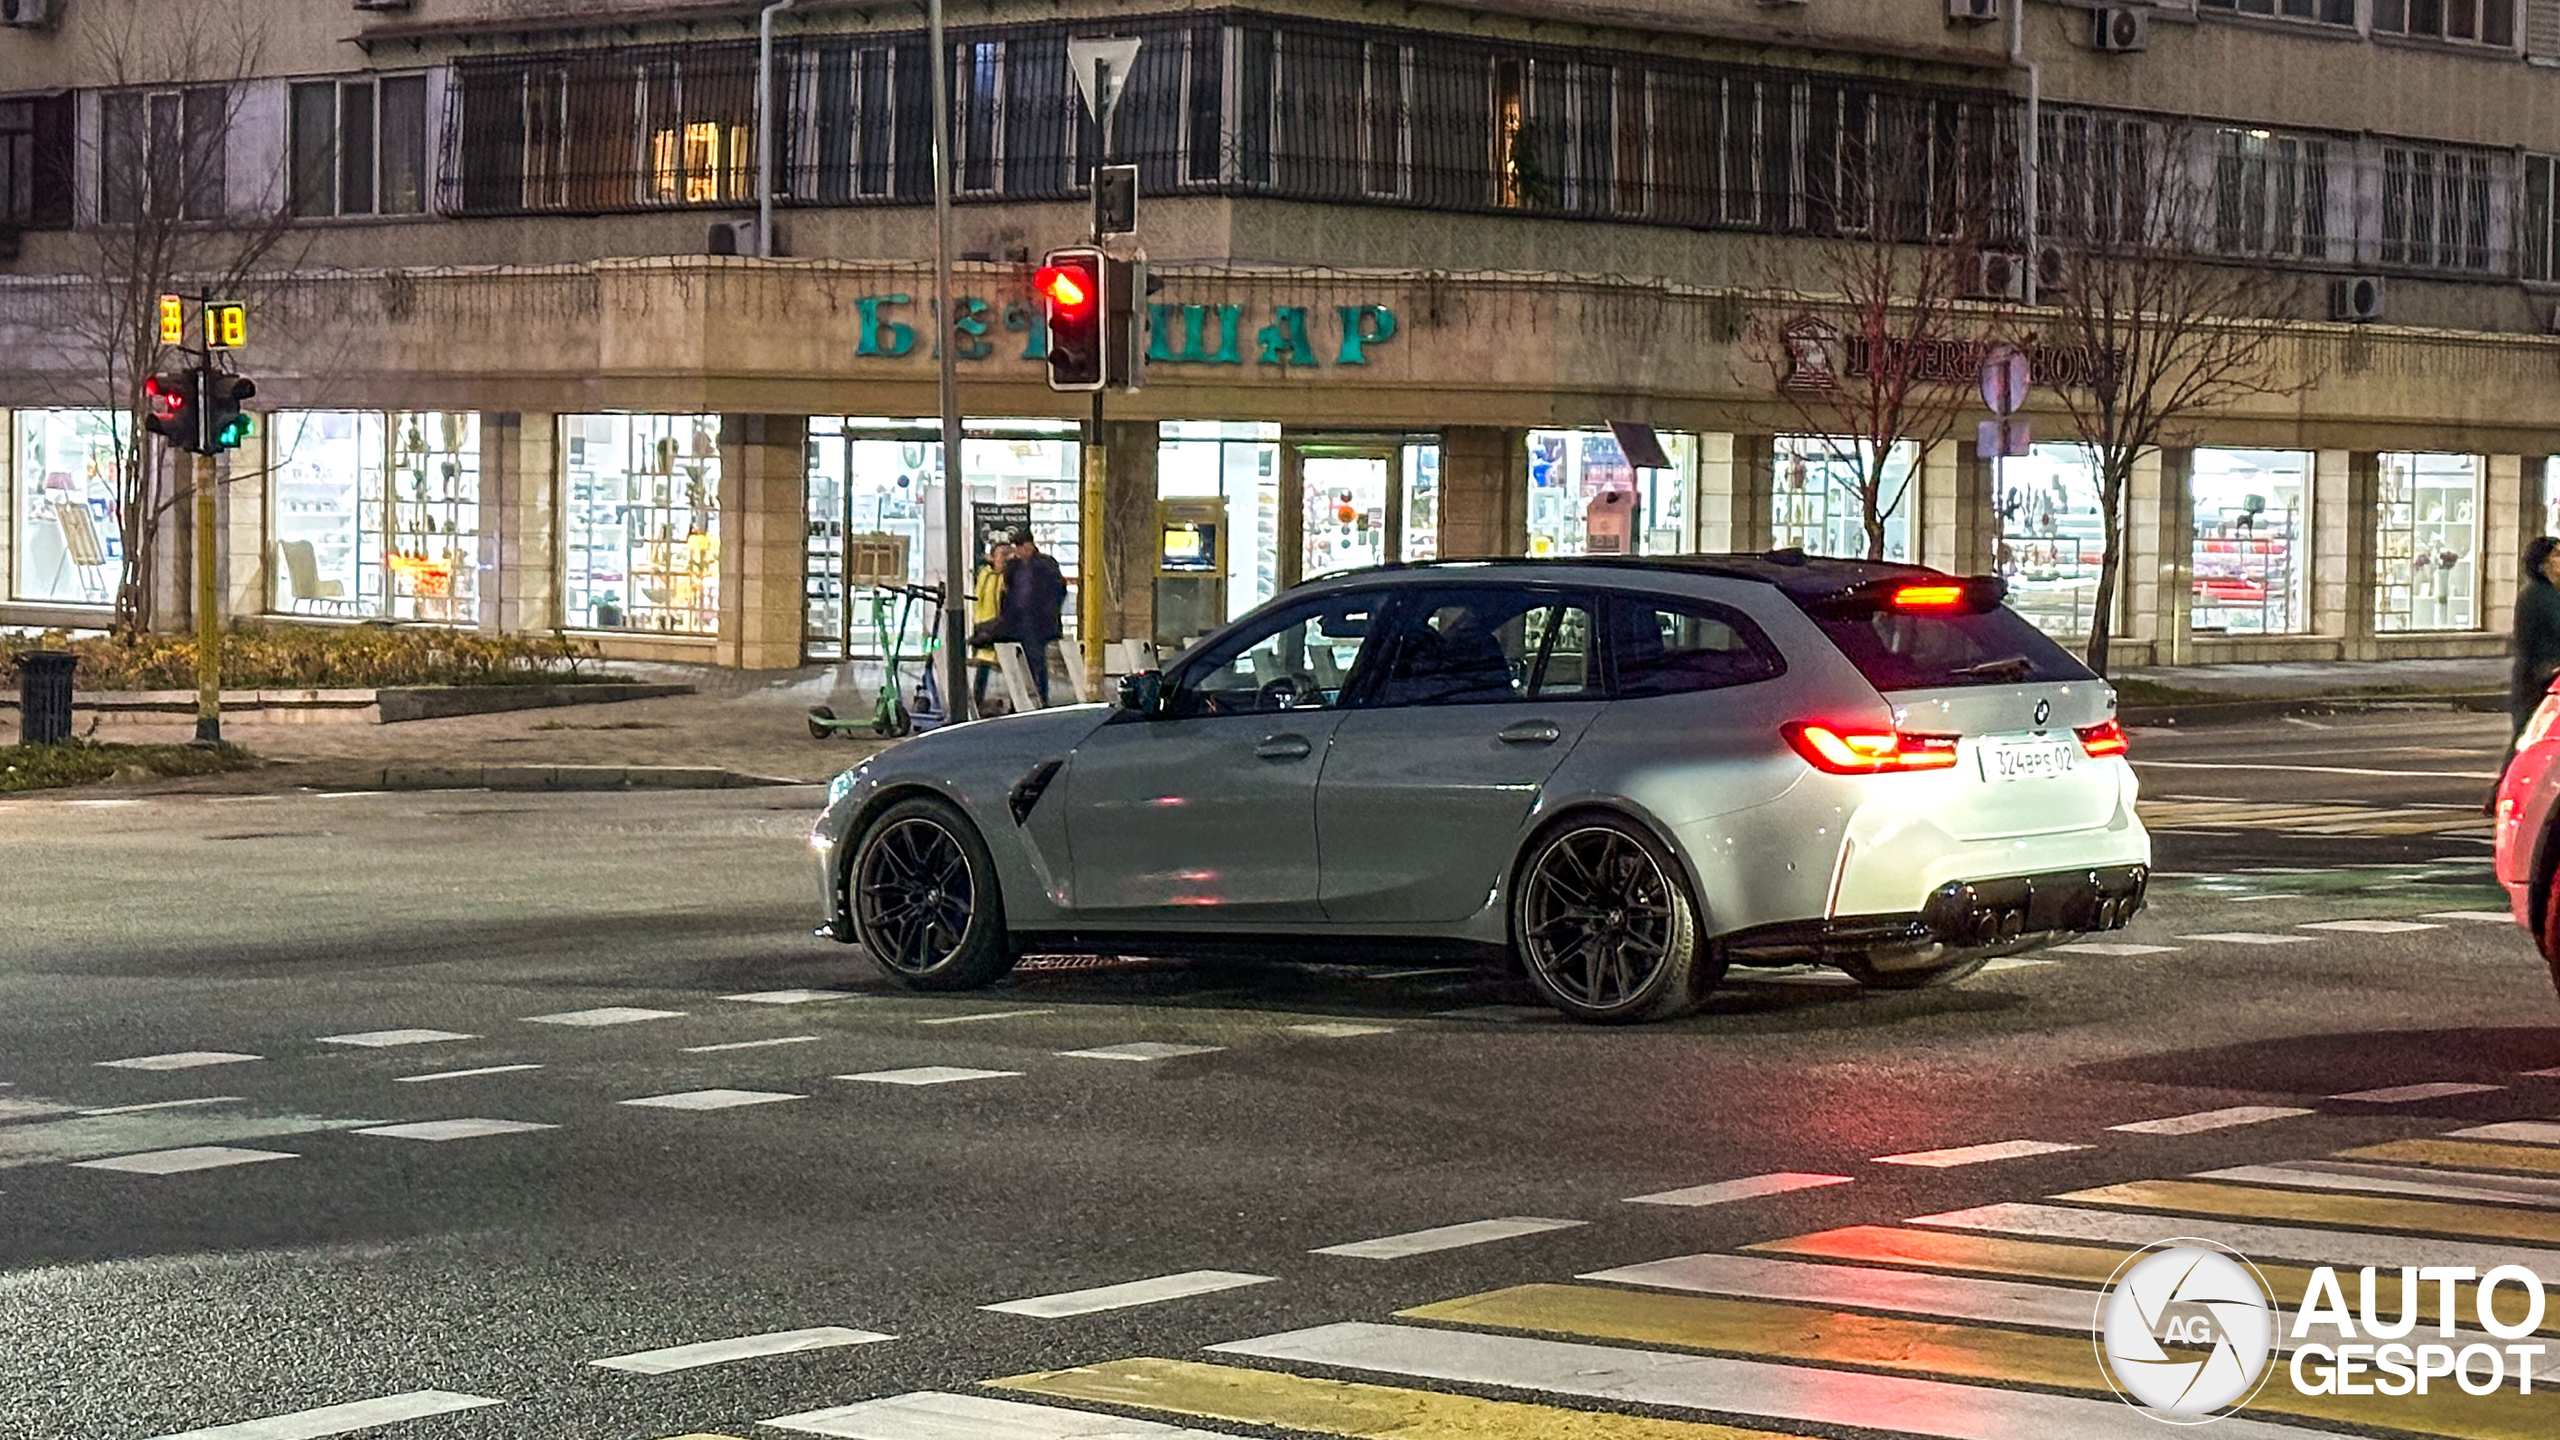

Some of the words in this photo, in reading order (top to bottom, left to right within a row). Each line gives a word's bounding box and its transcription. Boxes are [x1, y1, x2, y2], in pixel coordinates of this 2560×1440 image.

[207, 306, 244, 345] 18
[854, 293, 1397, 367] БЕТШАР
[2054, 746, 2074, 772] 02
